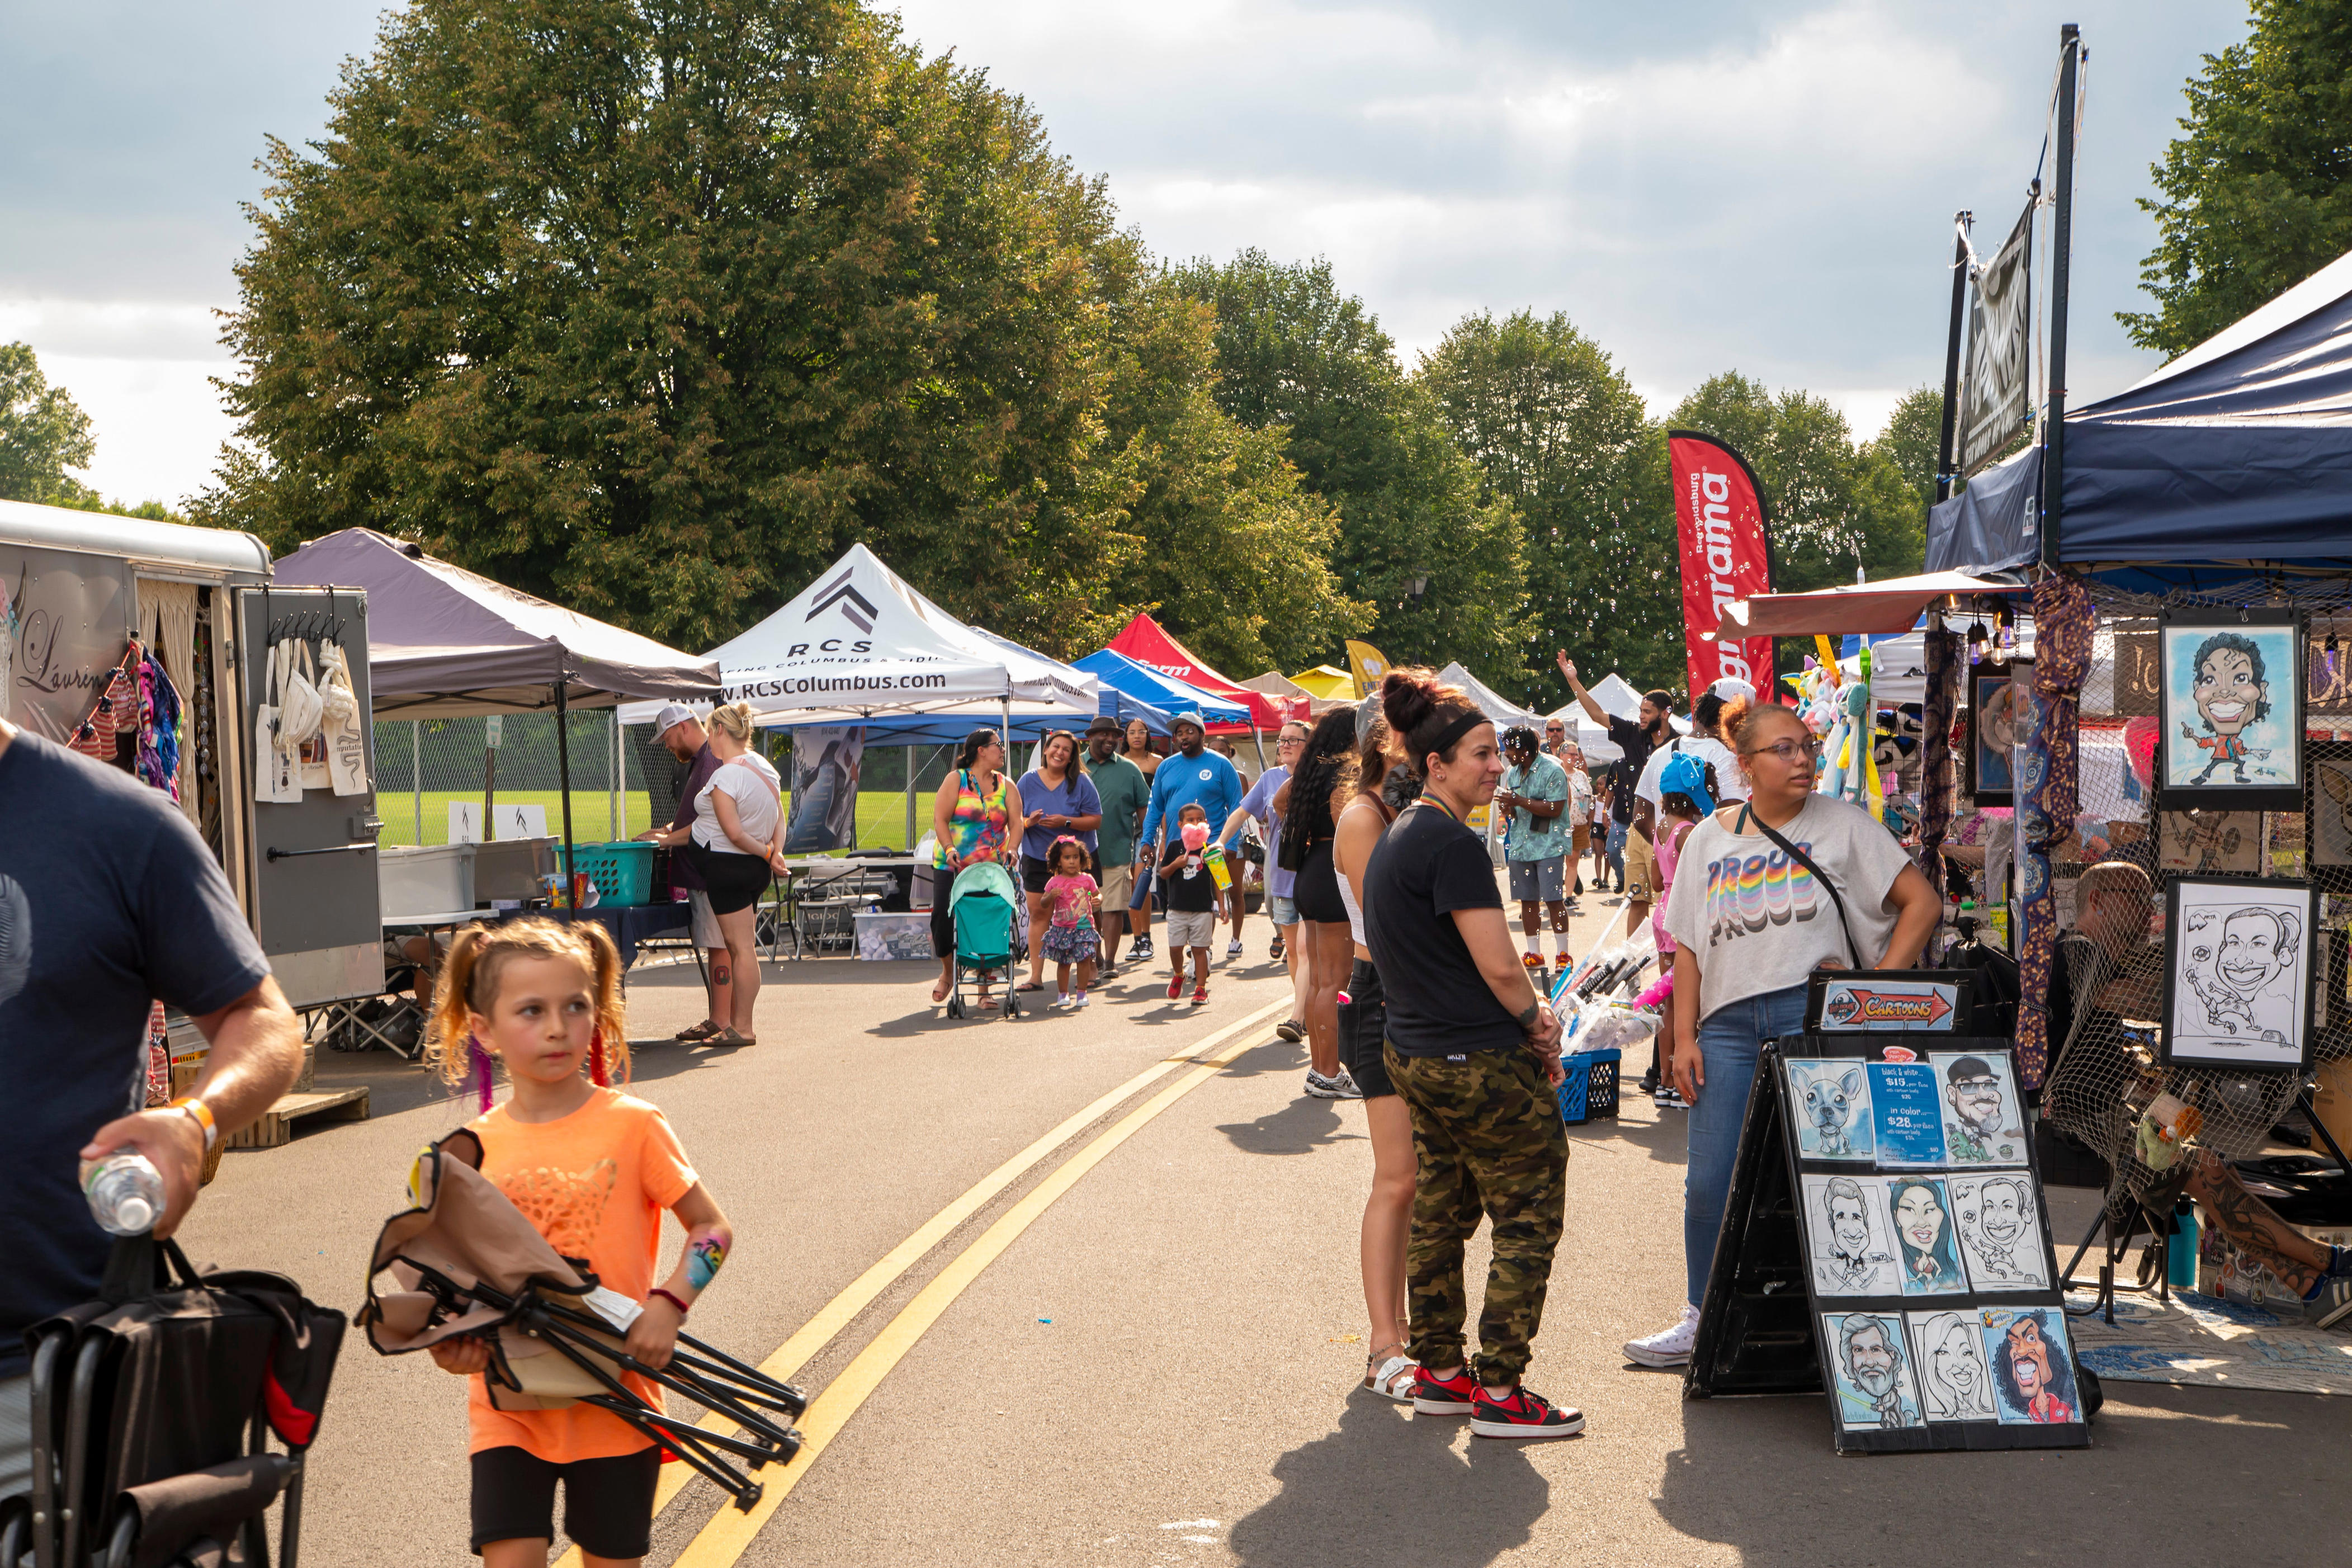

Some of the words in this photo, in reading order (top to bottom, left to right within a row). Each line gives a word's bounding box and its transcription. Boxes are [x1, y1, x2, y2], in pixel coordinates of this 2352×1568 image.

[1690, 473, 1703, 554] Reynoldsburg
[787, 639, 873, 658] RCS
[776, 658, 871, 669] COLUMBUS
[1362, 681, 1381, 691] ENT
[1707, 842, 1818, 948] PROUD
[1864, 996, 1933, 1018] CARTOONS
[1881, 1068, 1898, 1076] black
[1898, 1068, 1902, 1076] &
